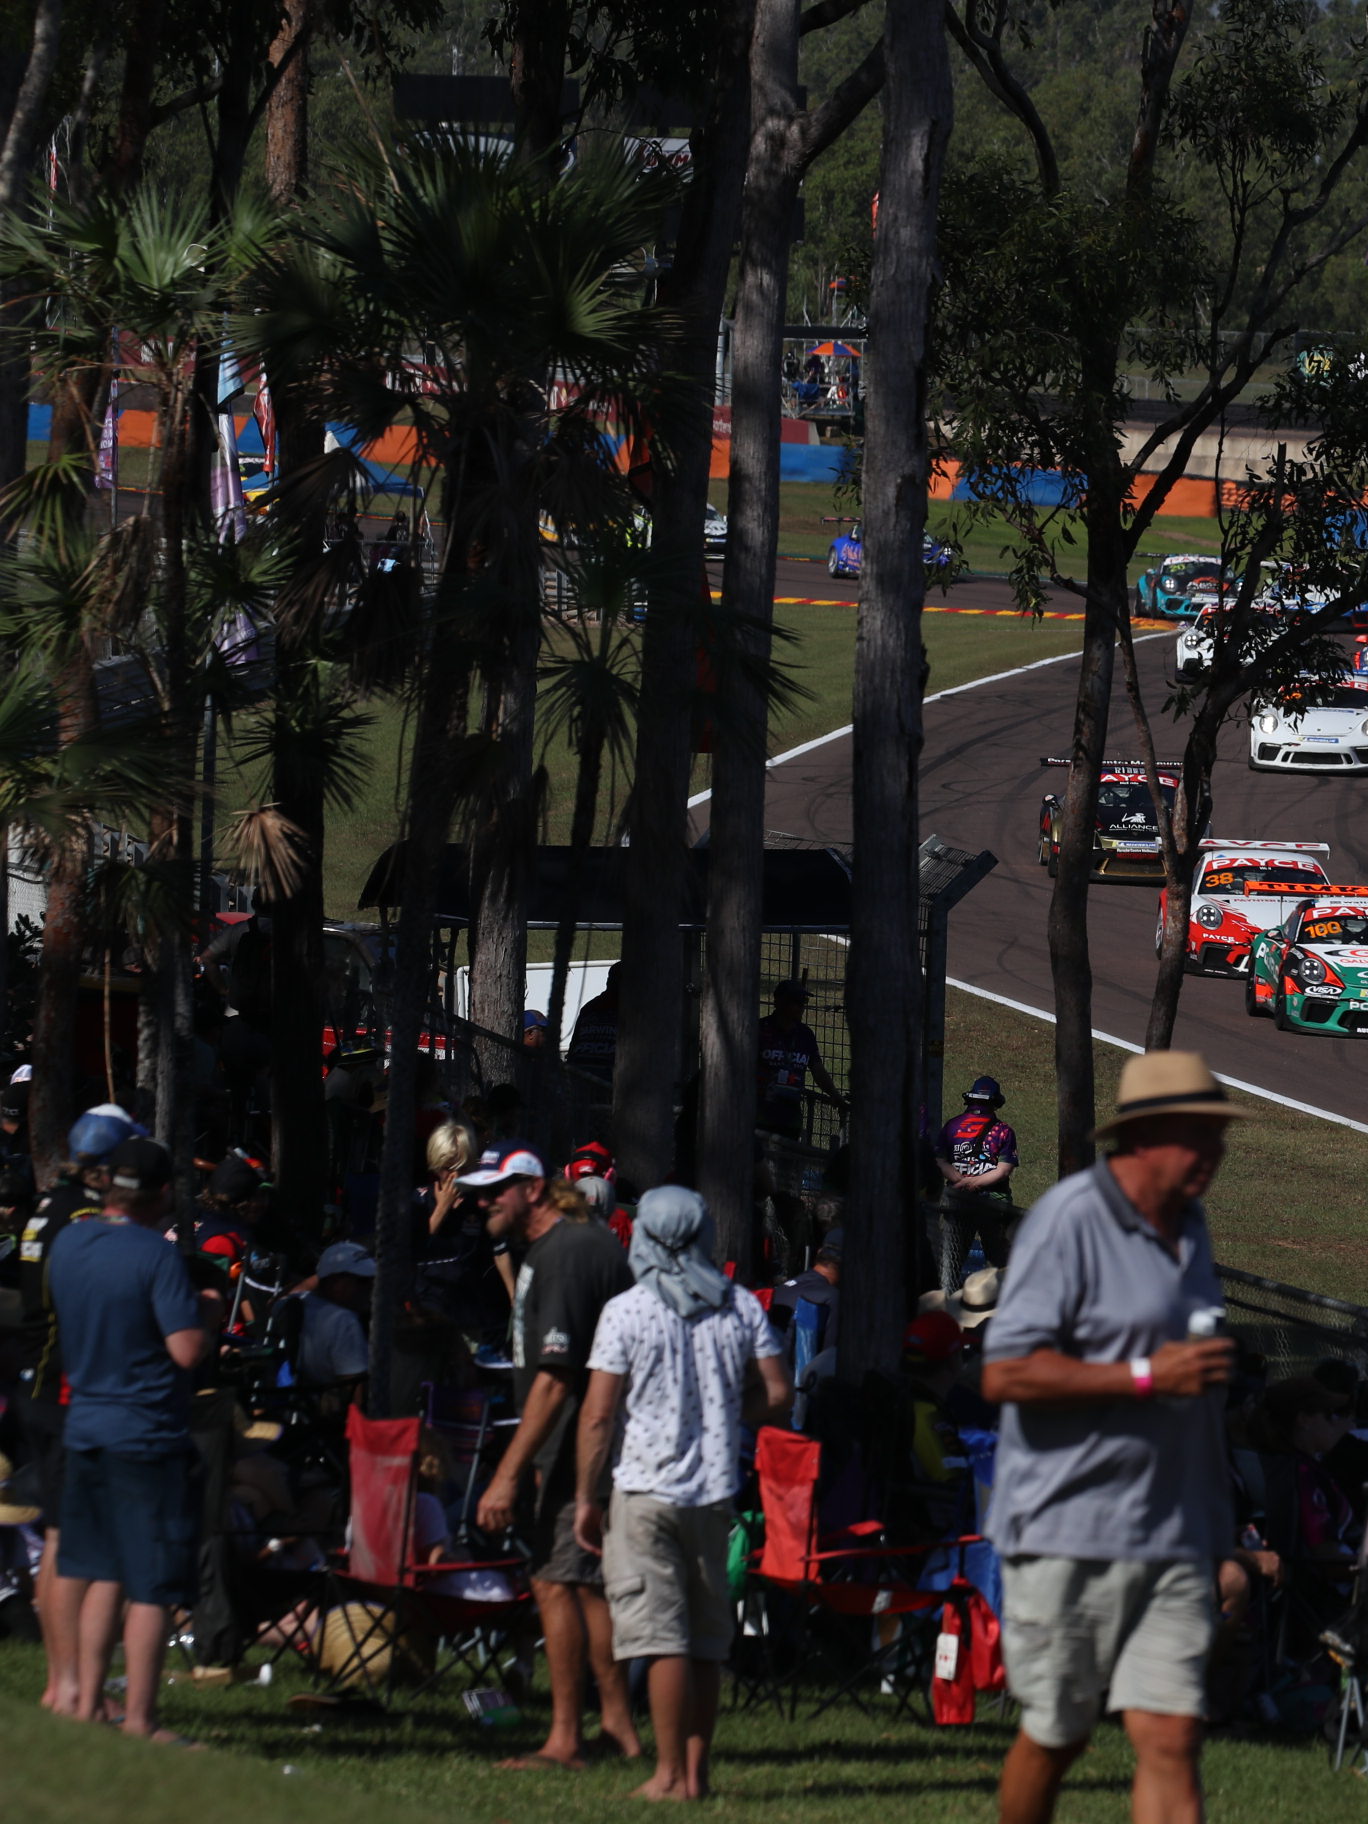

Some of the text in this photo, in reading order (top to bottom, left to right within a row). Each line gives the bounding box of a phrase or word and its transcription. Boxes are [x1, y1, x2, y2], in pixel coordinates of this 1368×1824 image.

[1100, 774, 1175, 787] AYCE
[1212, 858, 1316, 872] PAYCE
[1204, 872, 1236, 888] 38
[1304, 921, 1343, 939] 100
[1202, 933, 1235, 942] PAYCE
